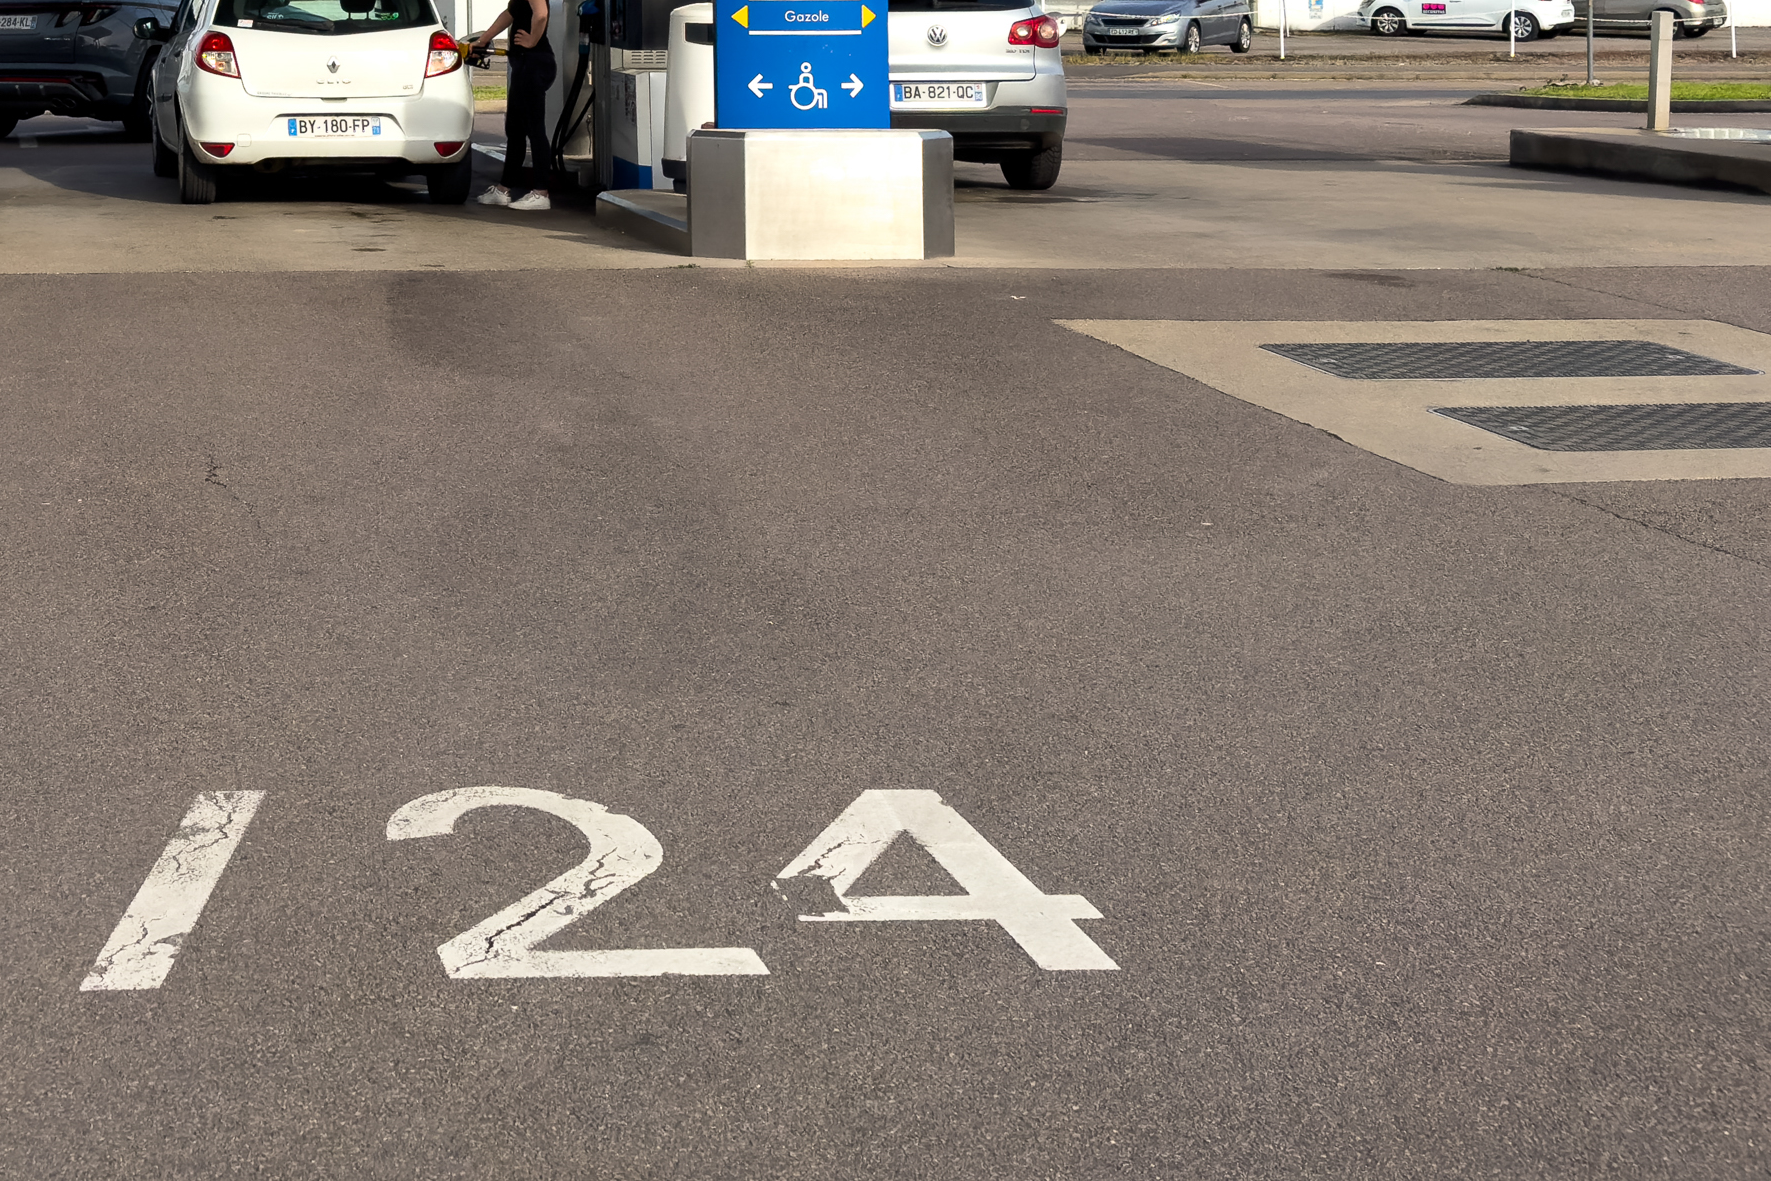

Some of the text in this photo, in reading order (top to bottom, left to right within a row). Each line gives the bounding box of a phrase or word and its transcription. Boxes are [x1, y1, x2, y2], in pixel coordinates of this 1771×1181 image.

[784, 10, 829, 22] Gazole
[903, 85, 974, 100] BA-821-QC
[299, 119, 370, 134] BY-180-FP
